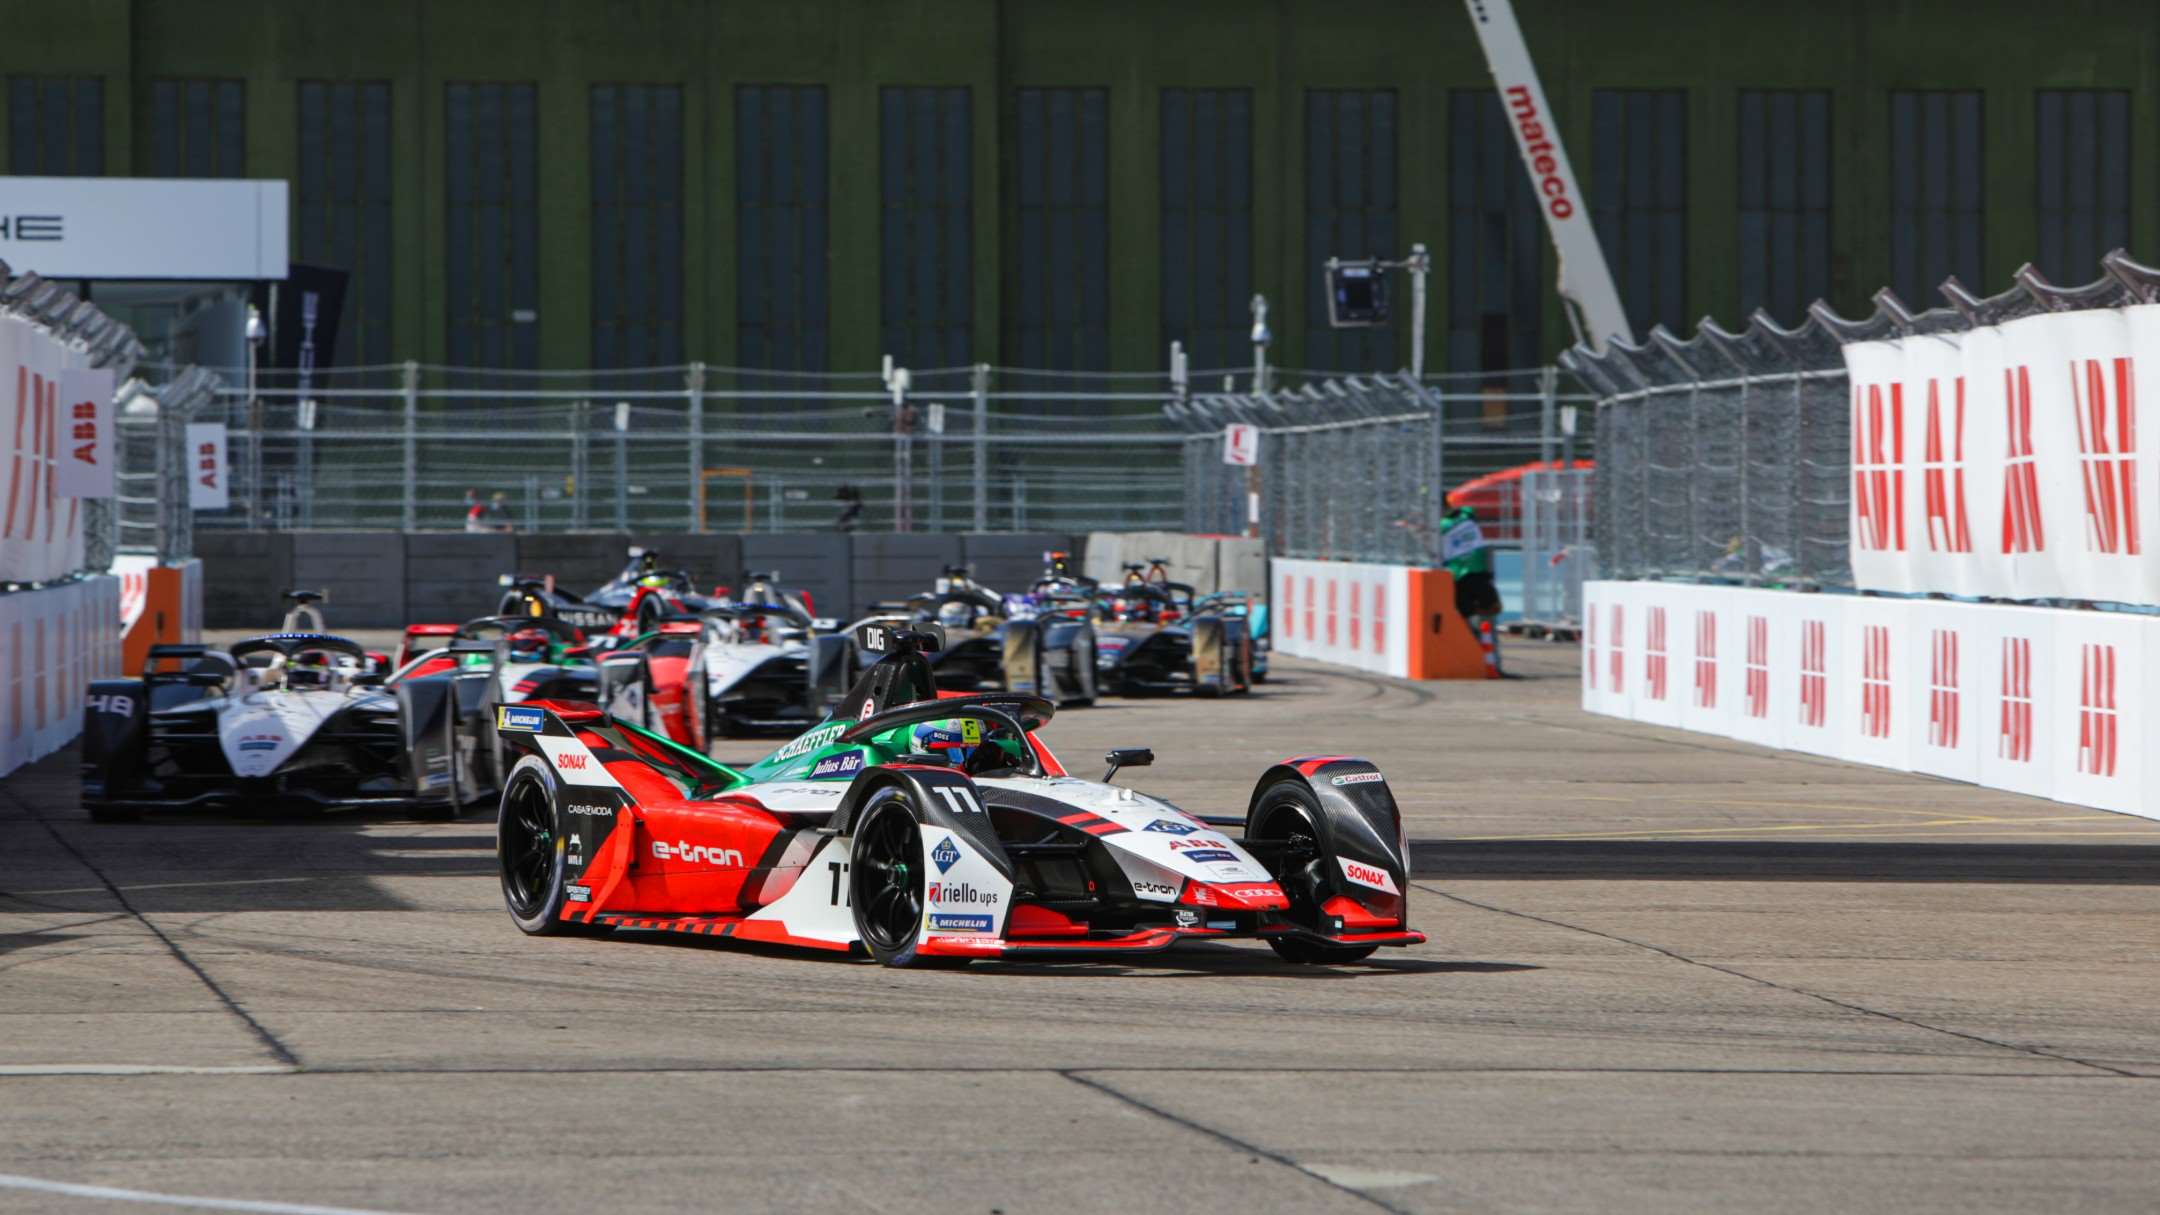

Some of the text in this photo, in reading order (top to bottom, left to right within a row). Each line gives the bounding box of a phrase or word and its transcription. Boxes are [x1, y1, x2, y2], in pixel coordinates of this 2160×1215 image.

[1506, 84, 1573, 220] mateco
[0, 214, 64, 241] E
[72, 401, 97, 465] ABB
[199, 441, 217, 490] ABB
[866, 627, 885, 651] DIG
[86, 695, 135, 718] 48
[773, 724, 846, 764] SCHAEFFLER
[558, 754, 588, 770] SONAX
[810, 755, 861, 777] Julius Bär
[1345, 773, 1380, 783] Castrol
[932, 786, 981, 813] 11
[652, 839, 744, 868] e-tron
[935, 850, 957, 863] LGT
[1169, 839, 1227, 851] ABB
[1347, 864, 1385, 887] SONAX
[943, 882, 998, 907] riello ups
[1133, 880, 1178, 896] e-tron
[939, 919, 988, 928] MICHELIN
